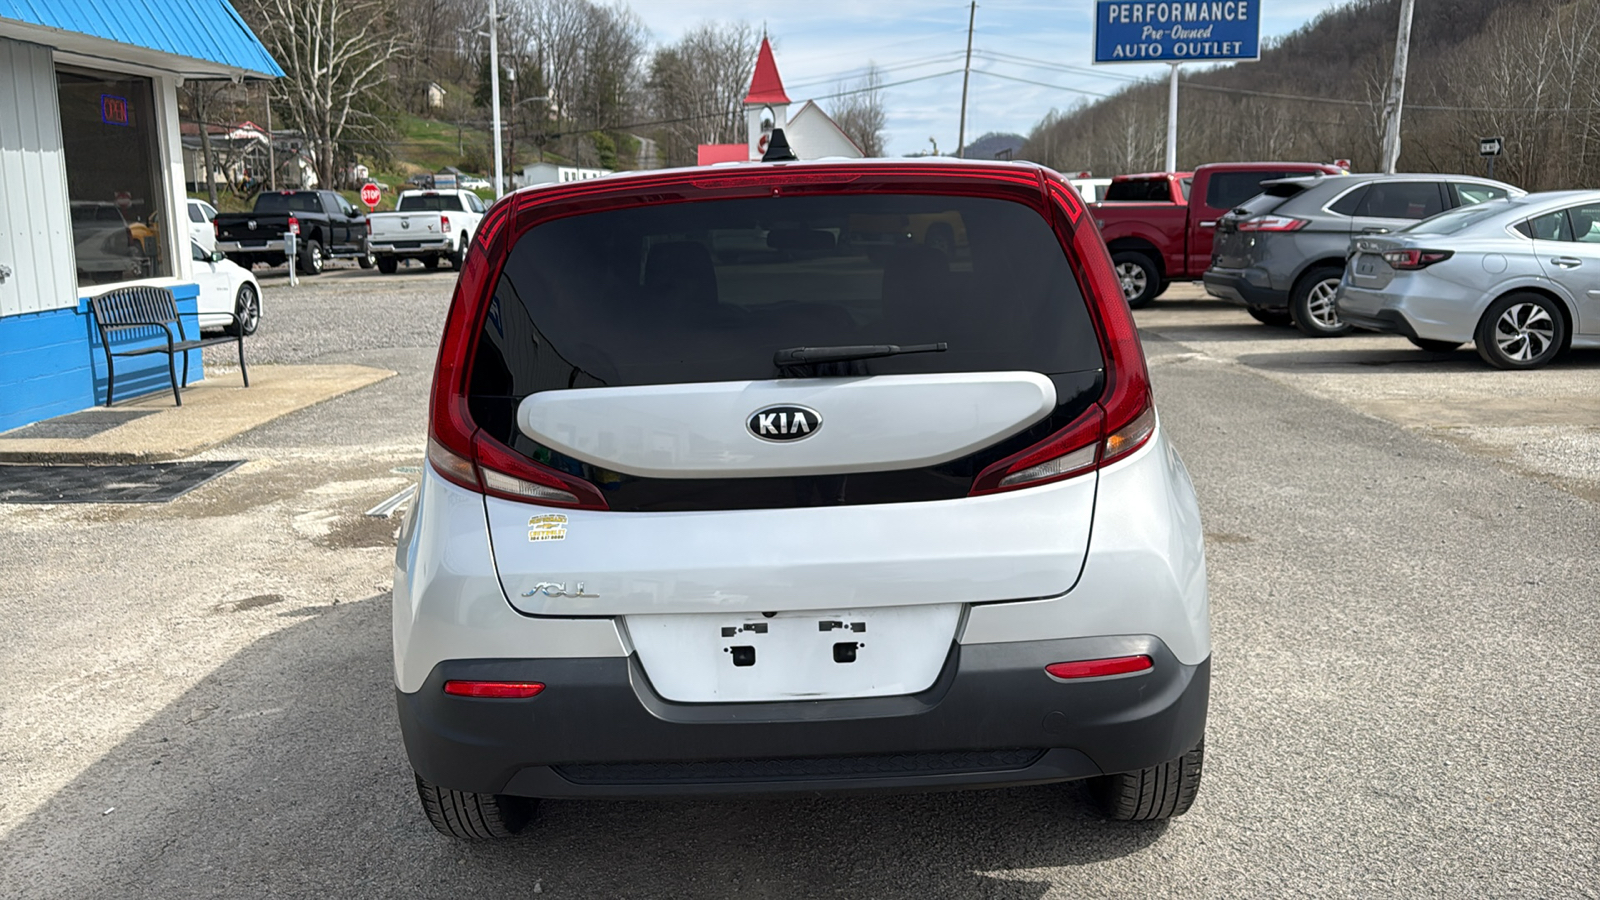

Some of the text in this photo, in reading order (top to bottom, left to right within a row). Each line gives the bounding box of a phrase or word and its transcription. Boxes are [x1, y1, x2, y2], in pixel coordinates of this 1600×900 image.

[1109, 1, 1248, 24] PERFORMANCE
[1141, 24, 1214, 41] Pre-Owned
[1112, 41, 1243, 58] AUTO OUTLET
[104, 97, 127, 121] OPEN
[362, 189, 380, 200] STOP
[758, 411, 811, 435] KIA
[521, 581, 600, 598] SOUL
